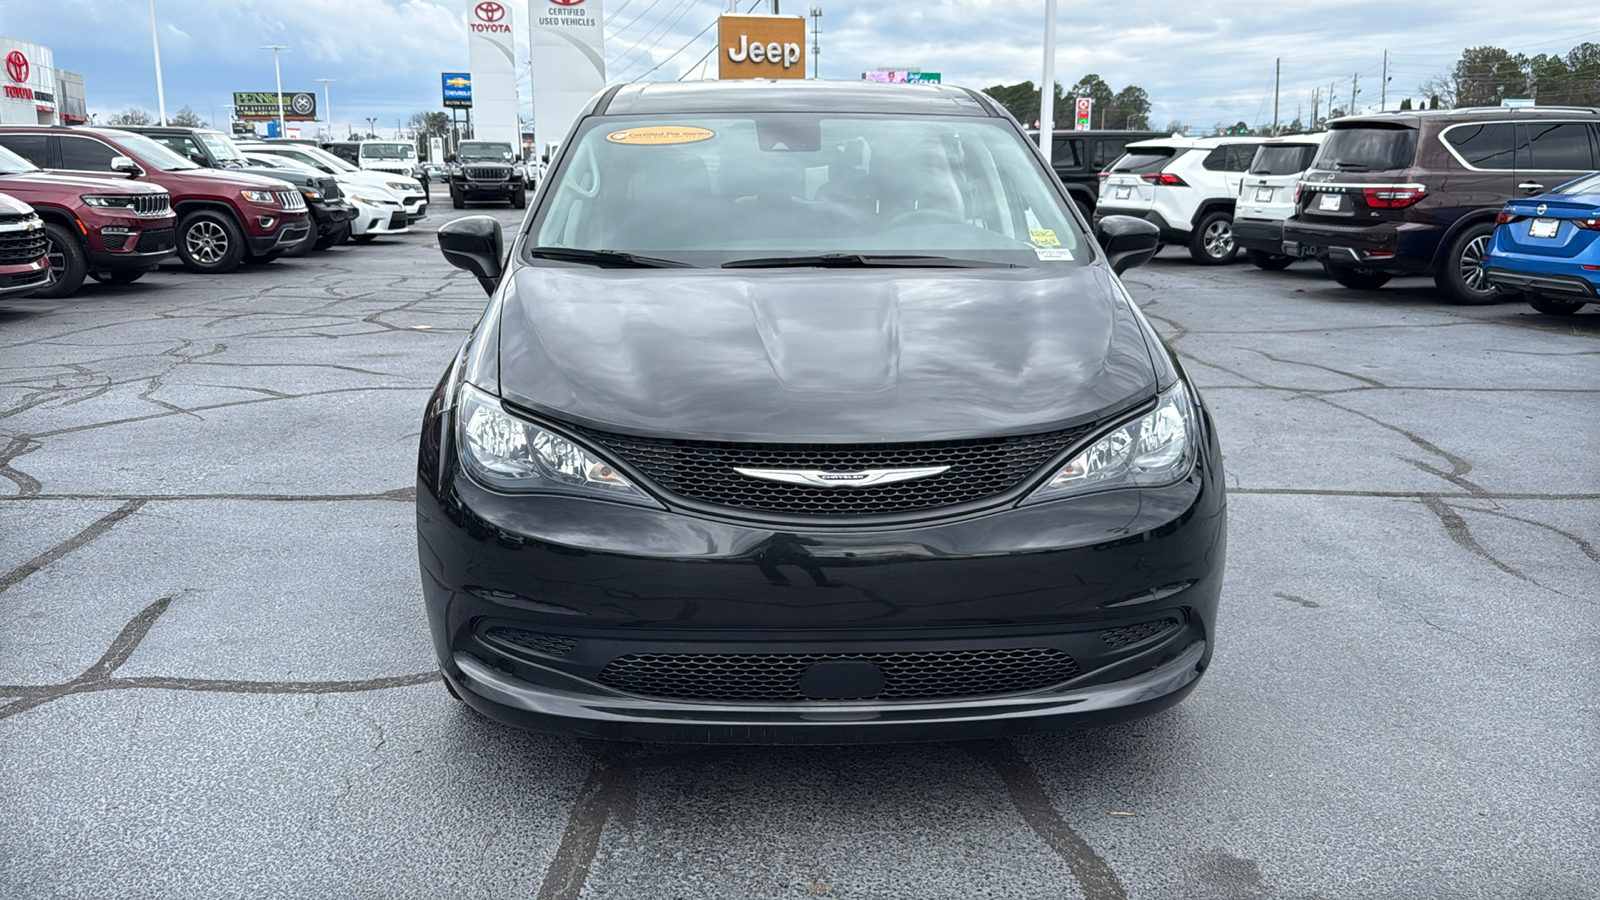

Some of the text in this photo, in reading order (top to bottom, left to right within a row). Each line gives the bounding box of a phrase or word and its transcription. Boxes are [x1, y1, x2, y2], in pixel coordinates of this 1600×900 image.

[548, 7, 585, 16] CERTIFIED
[539, 17, 596, 27] USED VEHICLES
[470, 23, 511, 33] TOYOTA
[727, 34, 801, 68] Jeep
[3, 85, 34, 100] TOYOTA
[235, 92, 268, 104] PENN
